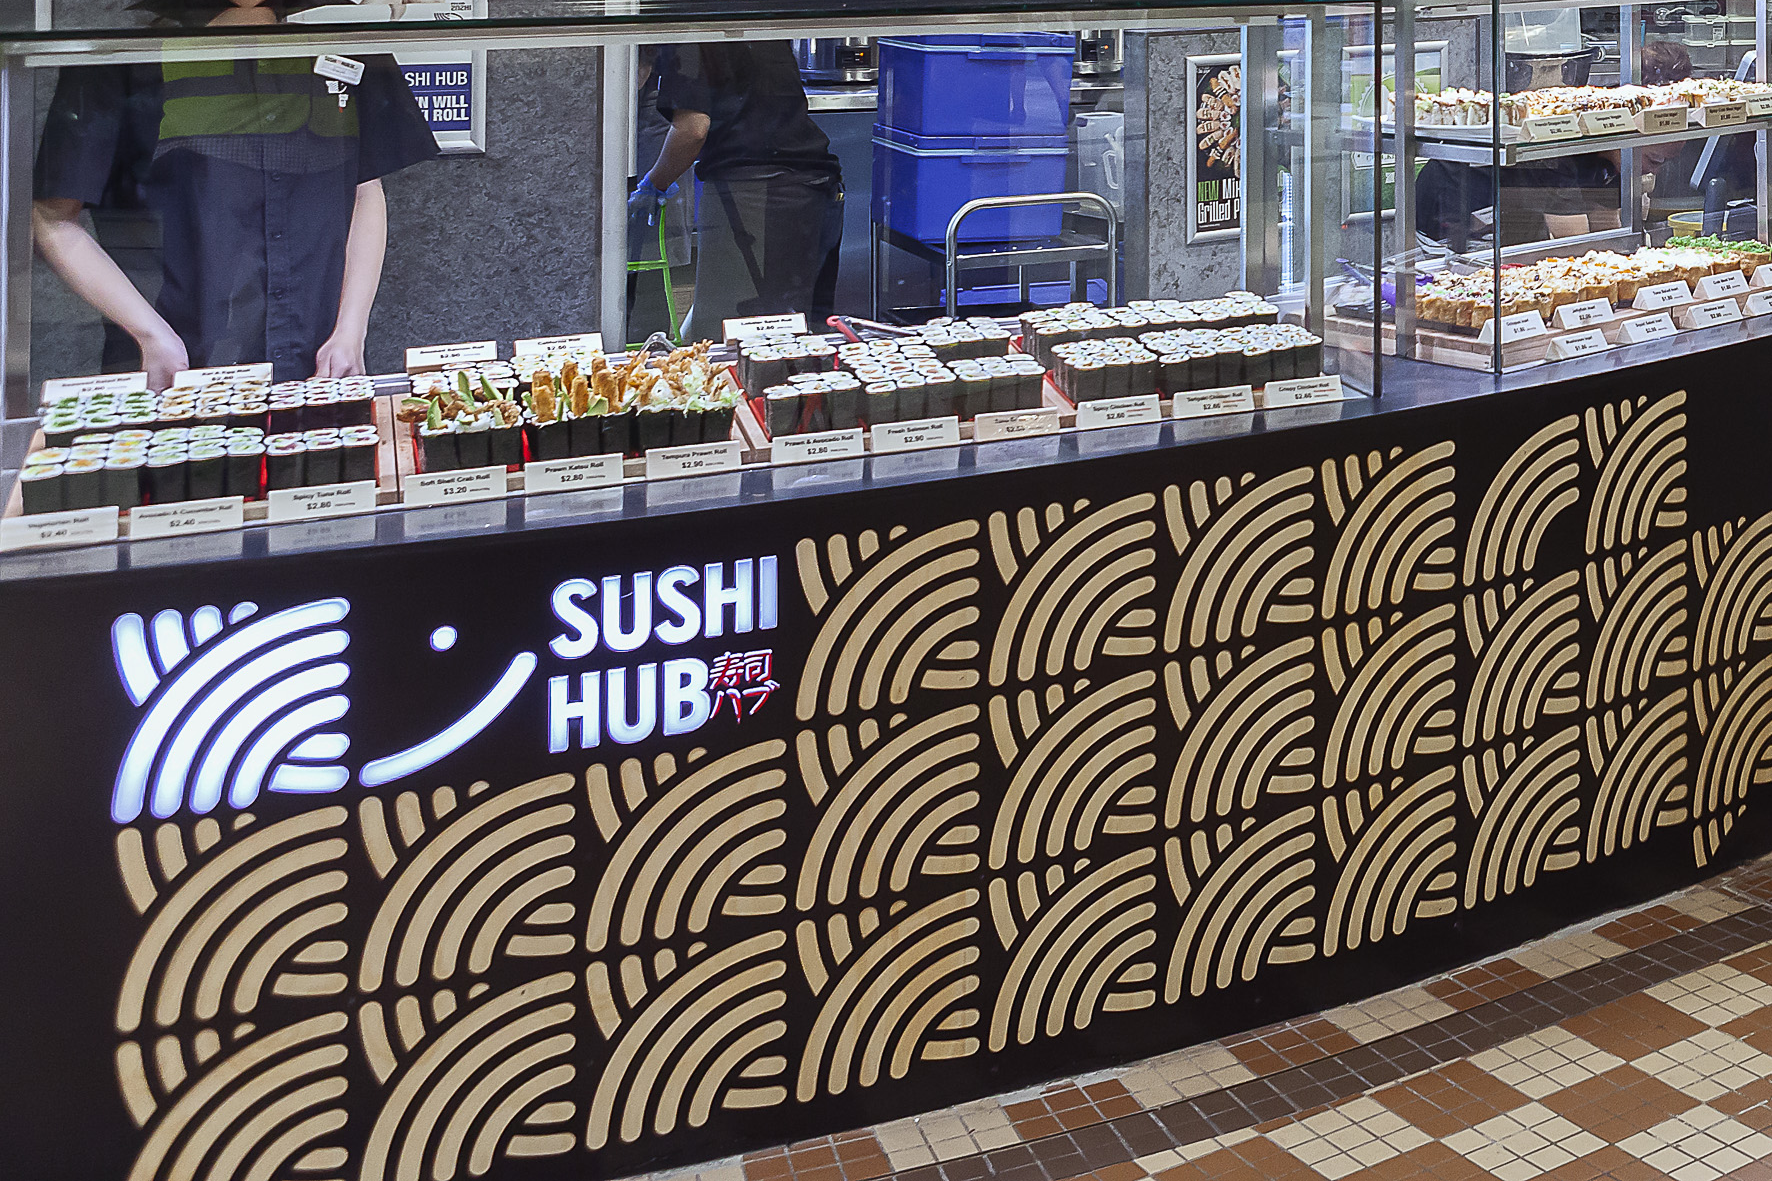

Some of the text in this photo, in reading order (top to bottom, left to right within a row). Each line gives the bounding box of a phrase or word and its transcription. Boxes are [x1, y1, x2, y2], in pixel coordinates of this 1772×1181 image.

[404, 71, 468, 86] SHI HUB
[432, 95, 468, 108] WILL
[433, 109, 469, 121] ROLL
[1198, 180, 1219, 201] NEW
[1197, 198, 1231, 223] Grilled
[548, 554, 779, 660] SUSHI
[709, 649, 773, 689] 寿司
[548, 657, 710, 753] HUB
